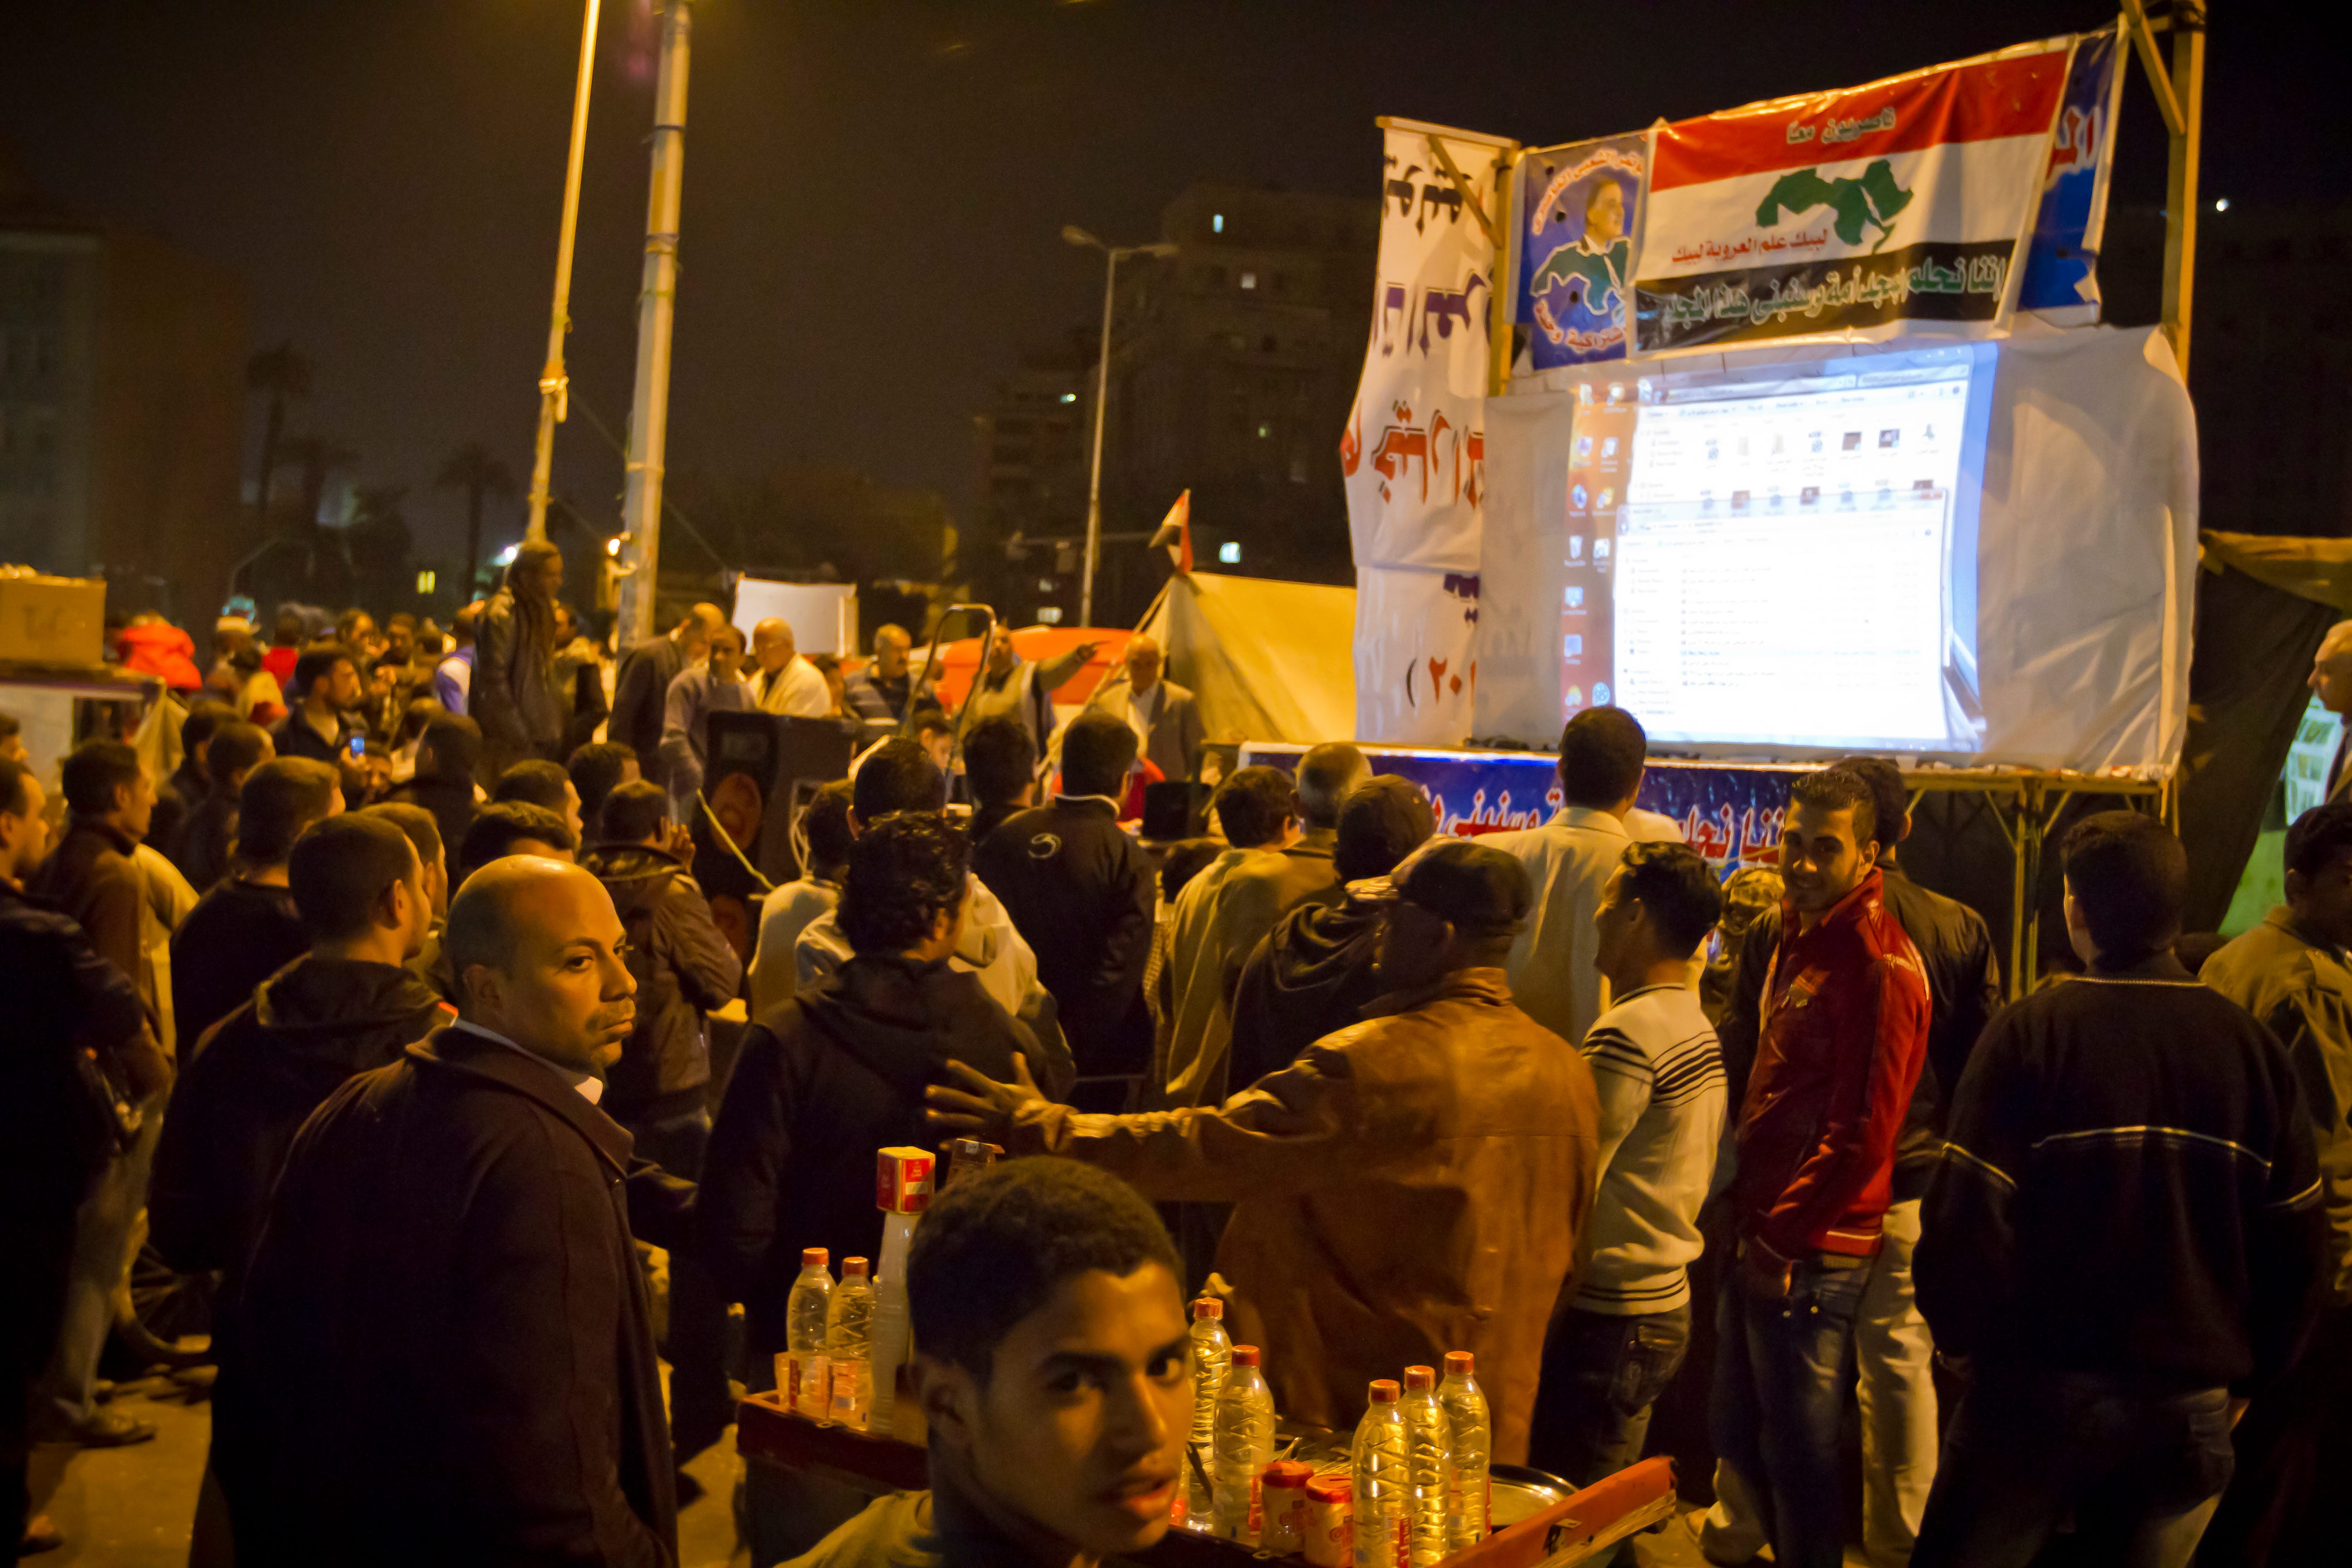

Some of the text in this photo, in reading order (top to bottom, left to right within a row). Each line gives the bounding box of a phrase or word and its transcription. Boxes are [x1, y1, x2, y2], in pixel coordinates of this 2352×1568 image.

[1789, 228, 1828, 252] لبيك
[1671, 243, 1704, 265] لبيك
[1908, 255, 1967, 294] نحلم
